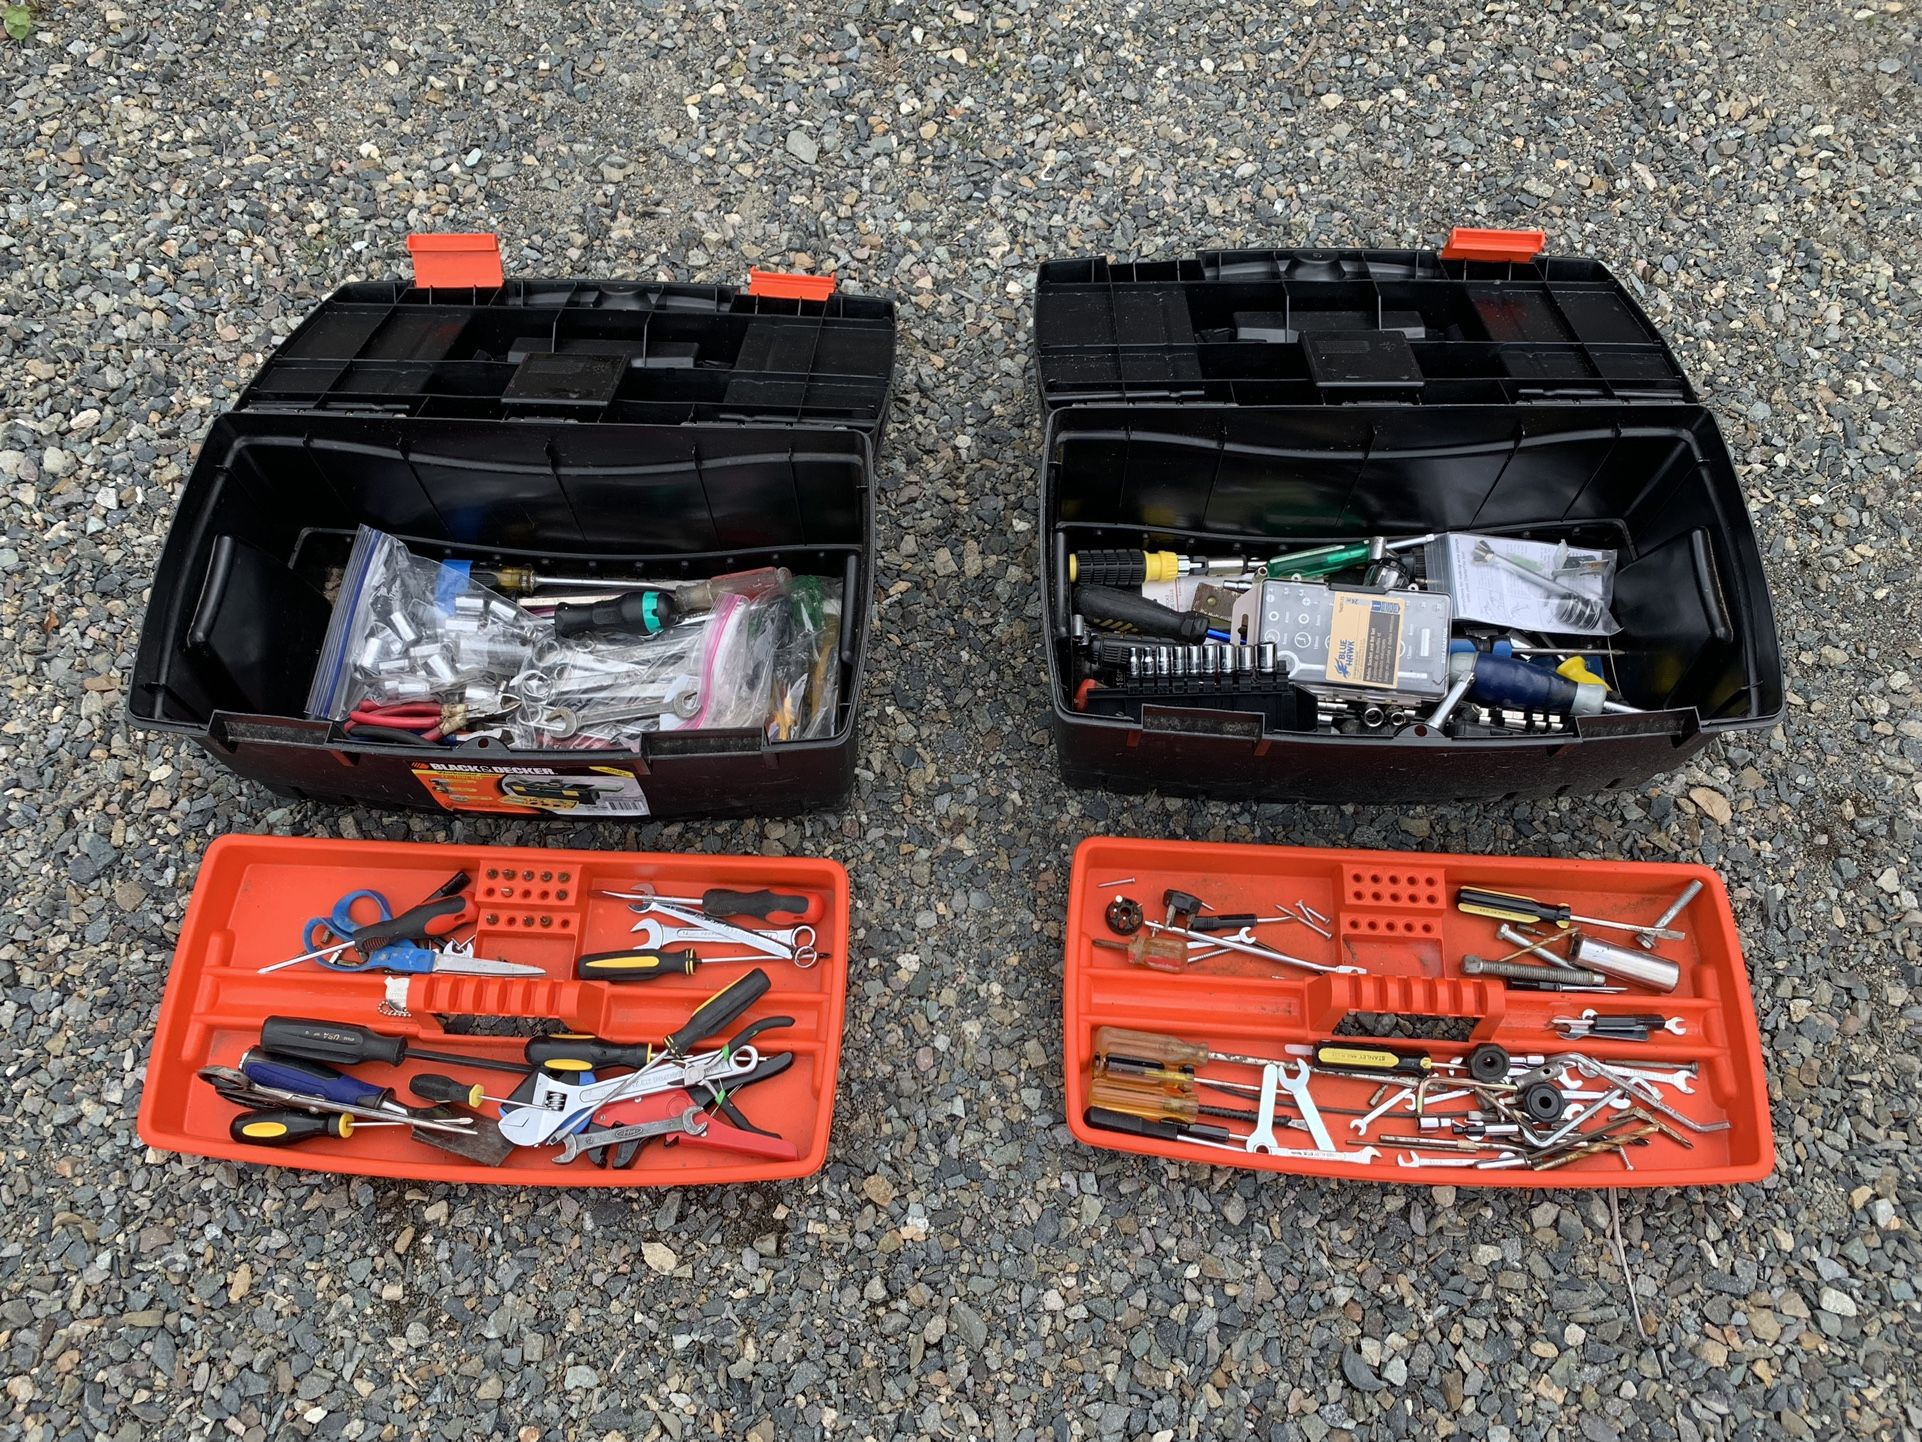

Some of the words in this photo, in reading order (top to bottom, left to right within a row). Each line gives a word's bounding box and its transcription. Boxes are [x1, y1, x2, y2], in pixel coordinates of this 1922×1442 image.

[1339, 639, 1347, 660] BLUE
[1346, 640, 1355, 666] HAWK
[323, 1032, 340, 1041] USA
[1359, 1053, 1386, 1061] STANLEY
